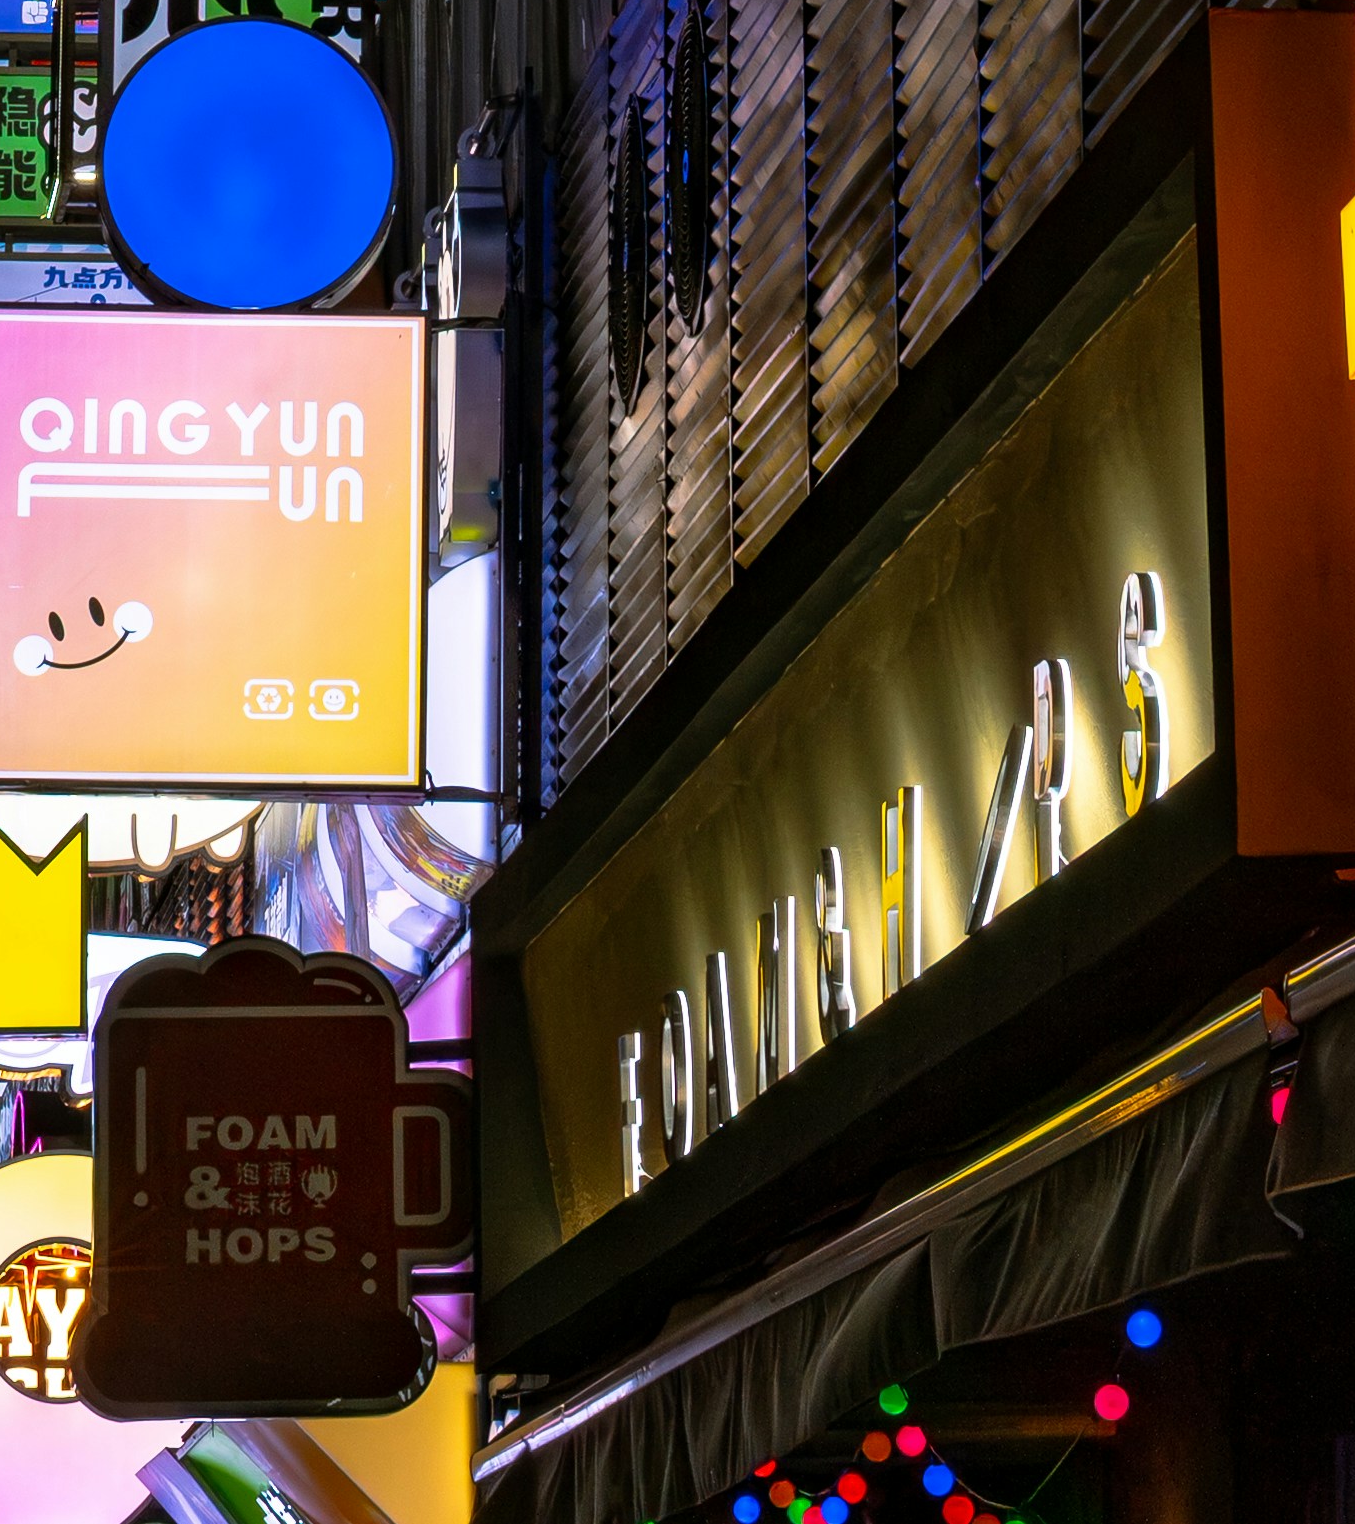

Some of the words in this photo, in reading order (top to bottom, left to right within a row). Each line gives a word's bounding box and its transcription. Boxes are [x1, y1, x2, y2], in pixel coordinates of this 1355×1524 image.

[17, 461, 364, 524] FUN
[185, 1114, 337, 1151] FOAM
[184, 1165, 233, 1210] &
[185, 1226, 337, 1265] HOPS
